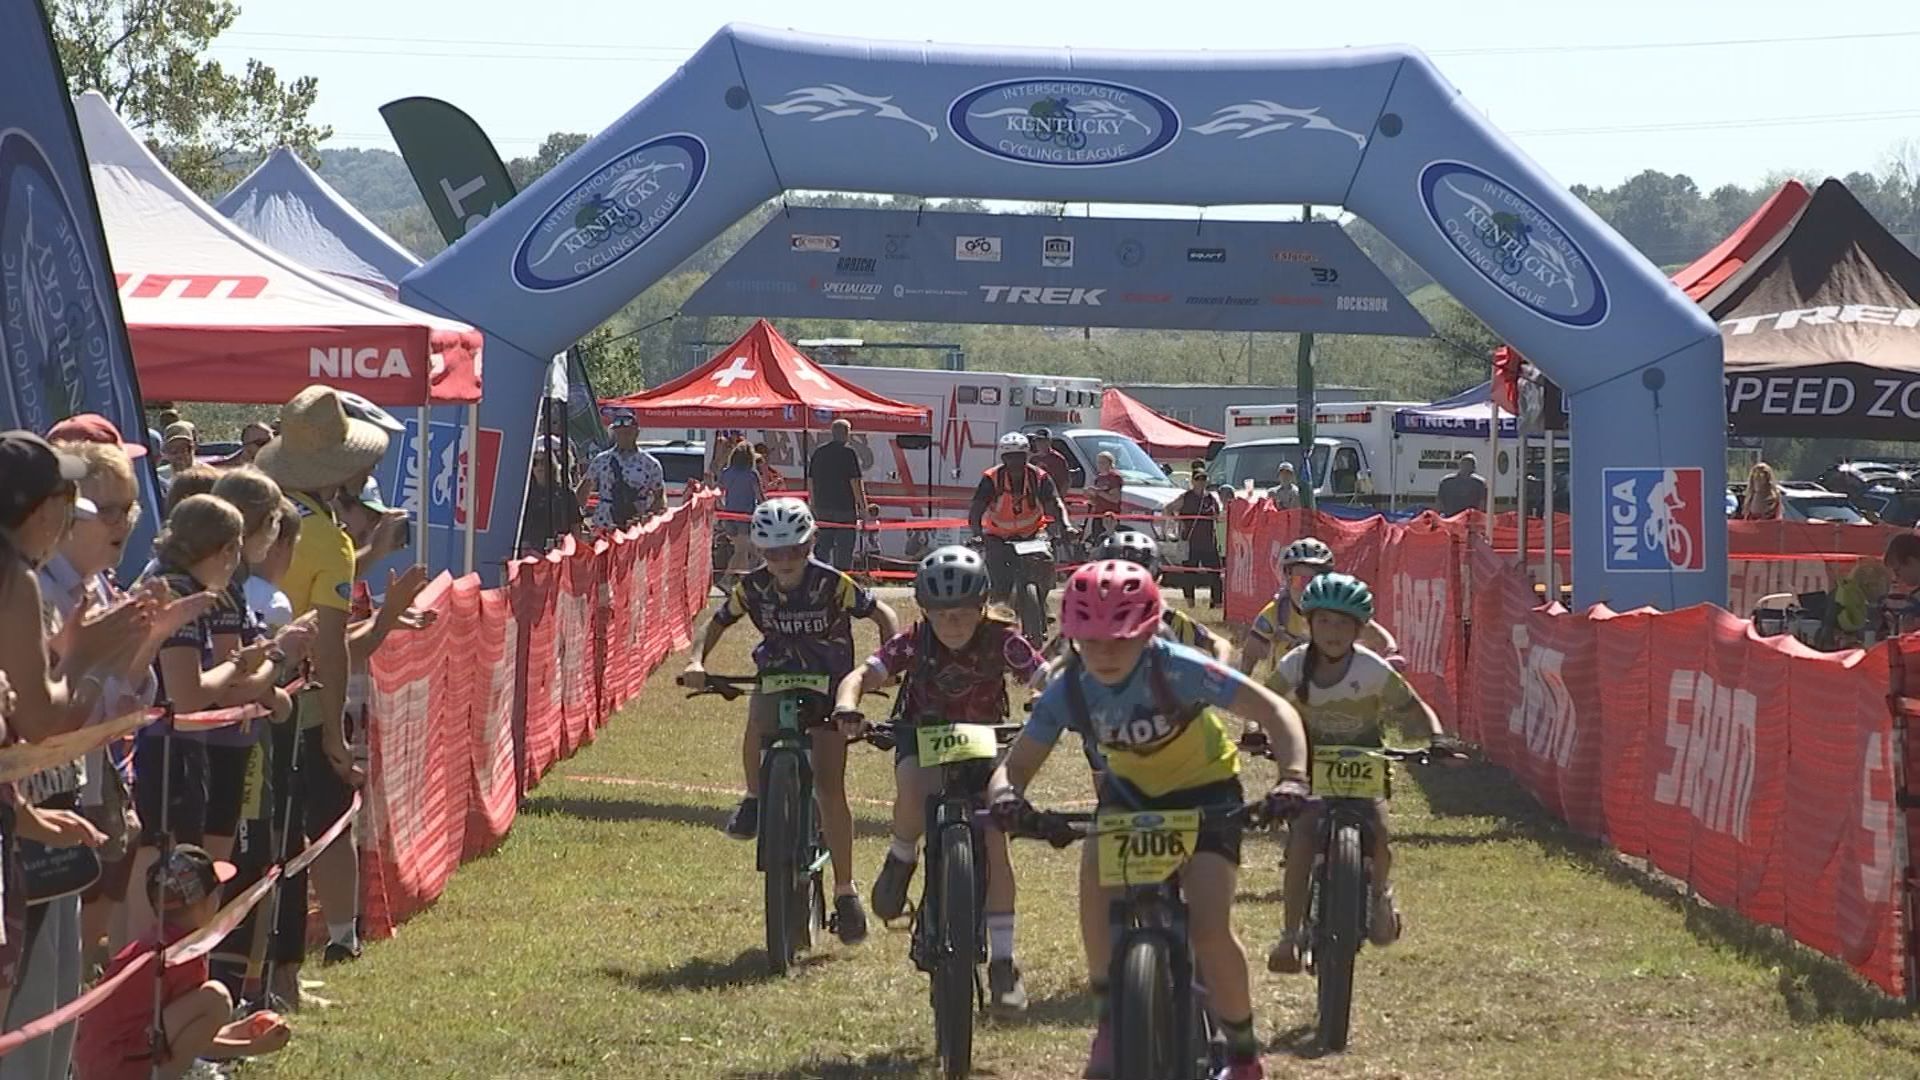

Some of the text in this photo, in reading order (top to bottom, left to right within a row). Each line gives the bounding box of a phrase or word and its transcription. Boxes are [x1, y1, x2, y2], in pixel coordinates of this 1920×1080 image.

[1002, 83, 1129, 104] INTERSCHOLASTIC
[1006, 115, 1124, 136] KENTUCKY
[998, 139, 1128, 161] CYCLING LEAGUE
[543, 151, 646, 233] INTERSCHOLASTIC
[563, 173, 661, 254] KENTUCKY
[574, 191, 681, 275] CYCLING LEAGUE
[1482, 182, 1583, 269] INTERSCHOLASTIC
[1445, 218, 1547, 307] CYCLING LEAGUE
[1464, 206, 1564, 288] KENTUCKY
[56, 217, 96, 331] LEAGUE
[823, 282, 883, 295] SPECIALIZED
[979, 285, 1109, 306] TREK
[309, 347, 412, 378] NICA
[1725, 377, 1856, 416] PEED
[1425, 416, 1466, 428] NICA
[1612, 478, 1638, 561] NICA
[1326, 760, 1374, 780] 7002
[1654, 669, 1758, 846] SRAM
[1113, 831, 1185, 859] 7006
